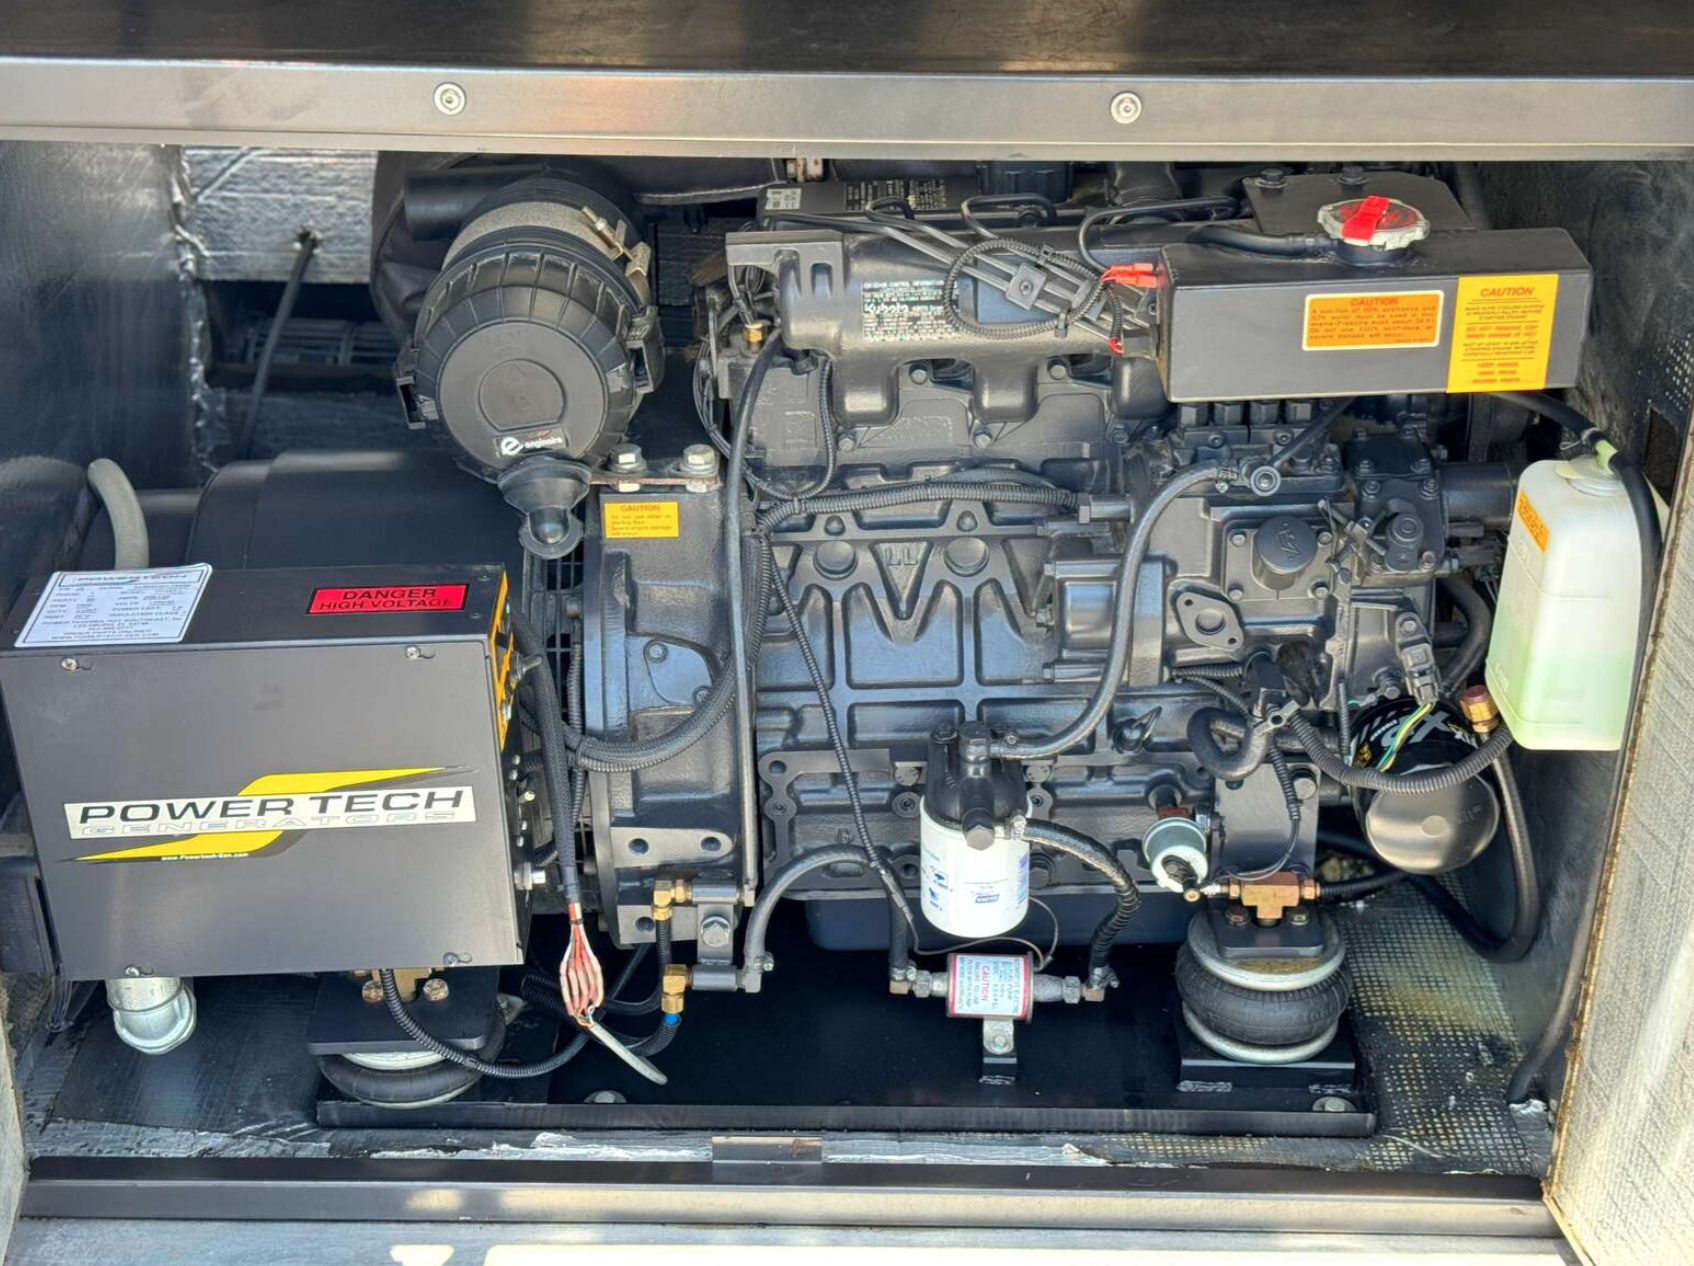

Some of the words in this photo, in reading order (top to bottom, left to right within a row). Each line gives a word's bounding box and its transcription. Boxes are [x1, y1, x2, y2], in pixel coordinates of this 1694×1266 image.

[1481, 287, 1534, 297] CAUTION
[1351, 297, 1398, 306] CAUTION
[865, 303, 908, 313] Kubota
[343, 589, 436, 599] DANGER
[320, 600, 364, 610] HIGH
[371, 599, 452, 608] VOLTAGE
[80, 798, 294, 824] POWER
[310, 790, 464, 814] TECH
[82, 812, 455, 835] GENERATORS
[981, 966, 989, 1001] CAUTION
